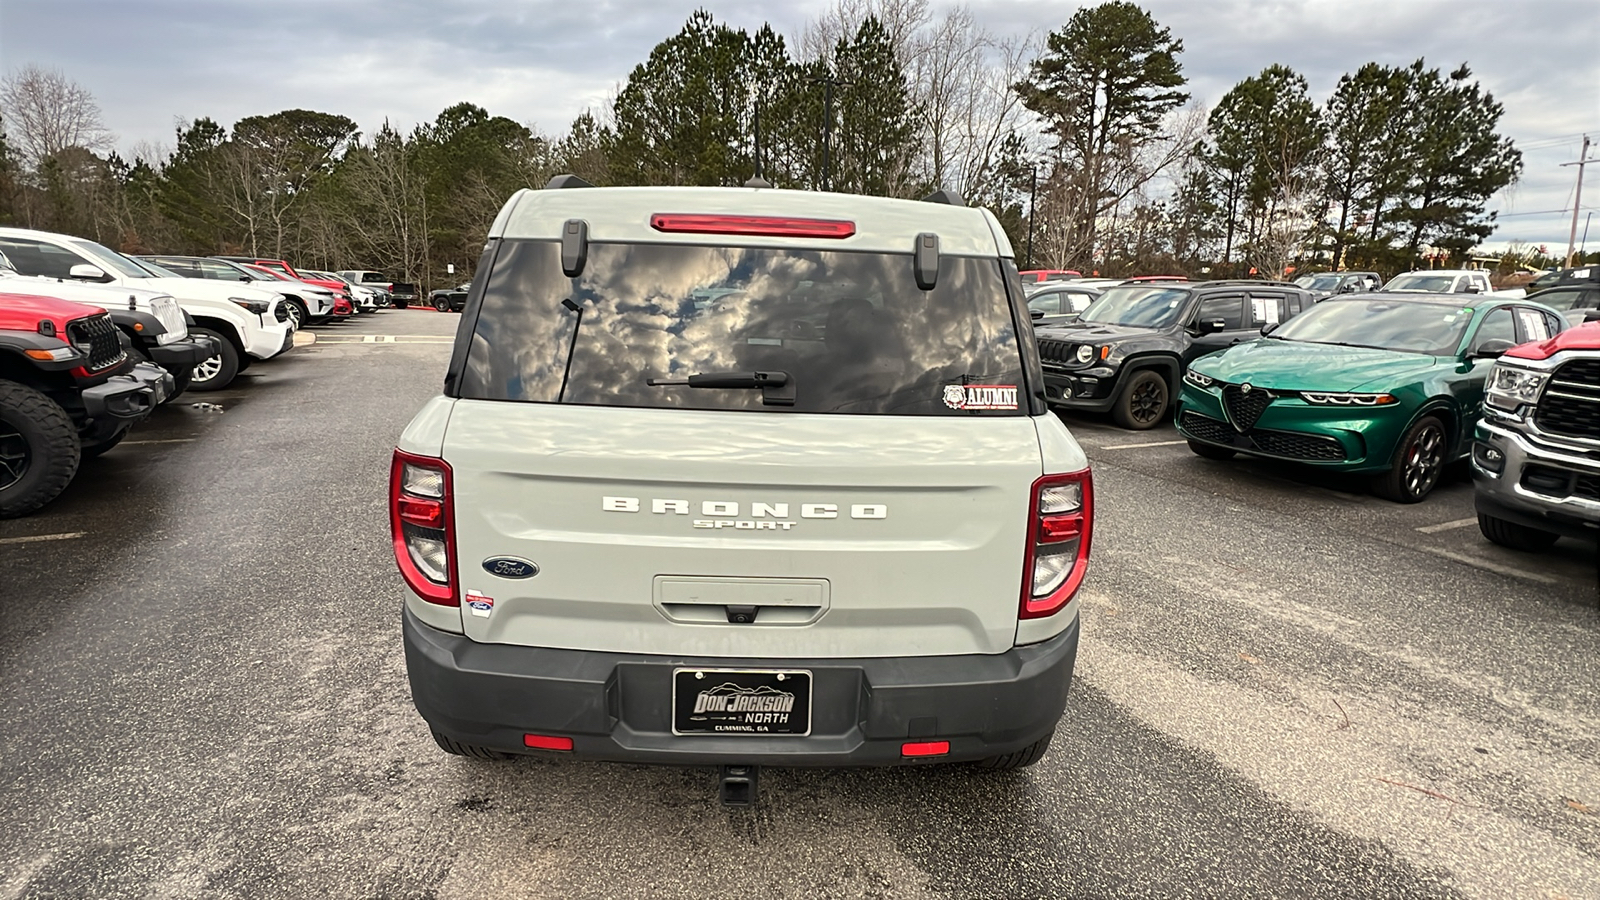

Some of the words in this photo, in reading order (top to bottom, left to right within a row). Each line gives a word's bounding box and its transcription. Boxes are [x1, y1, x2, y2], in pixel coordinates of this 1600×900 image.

[967, 388, 1018, 405] ALUMNI
[602, 496, 888, 519] BRONCO
[693, 519, 797, 530] SPORT
[494, 560, 525, 575] Ford
[745, 713, 789, 723] NORTH
